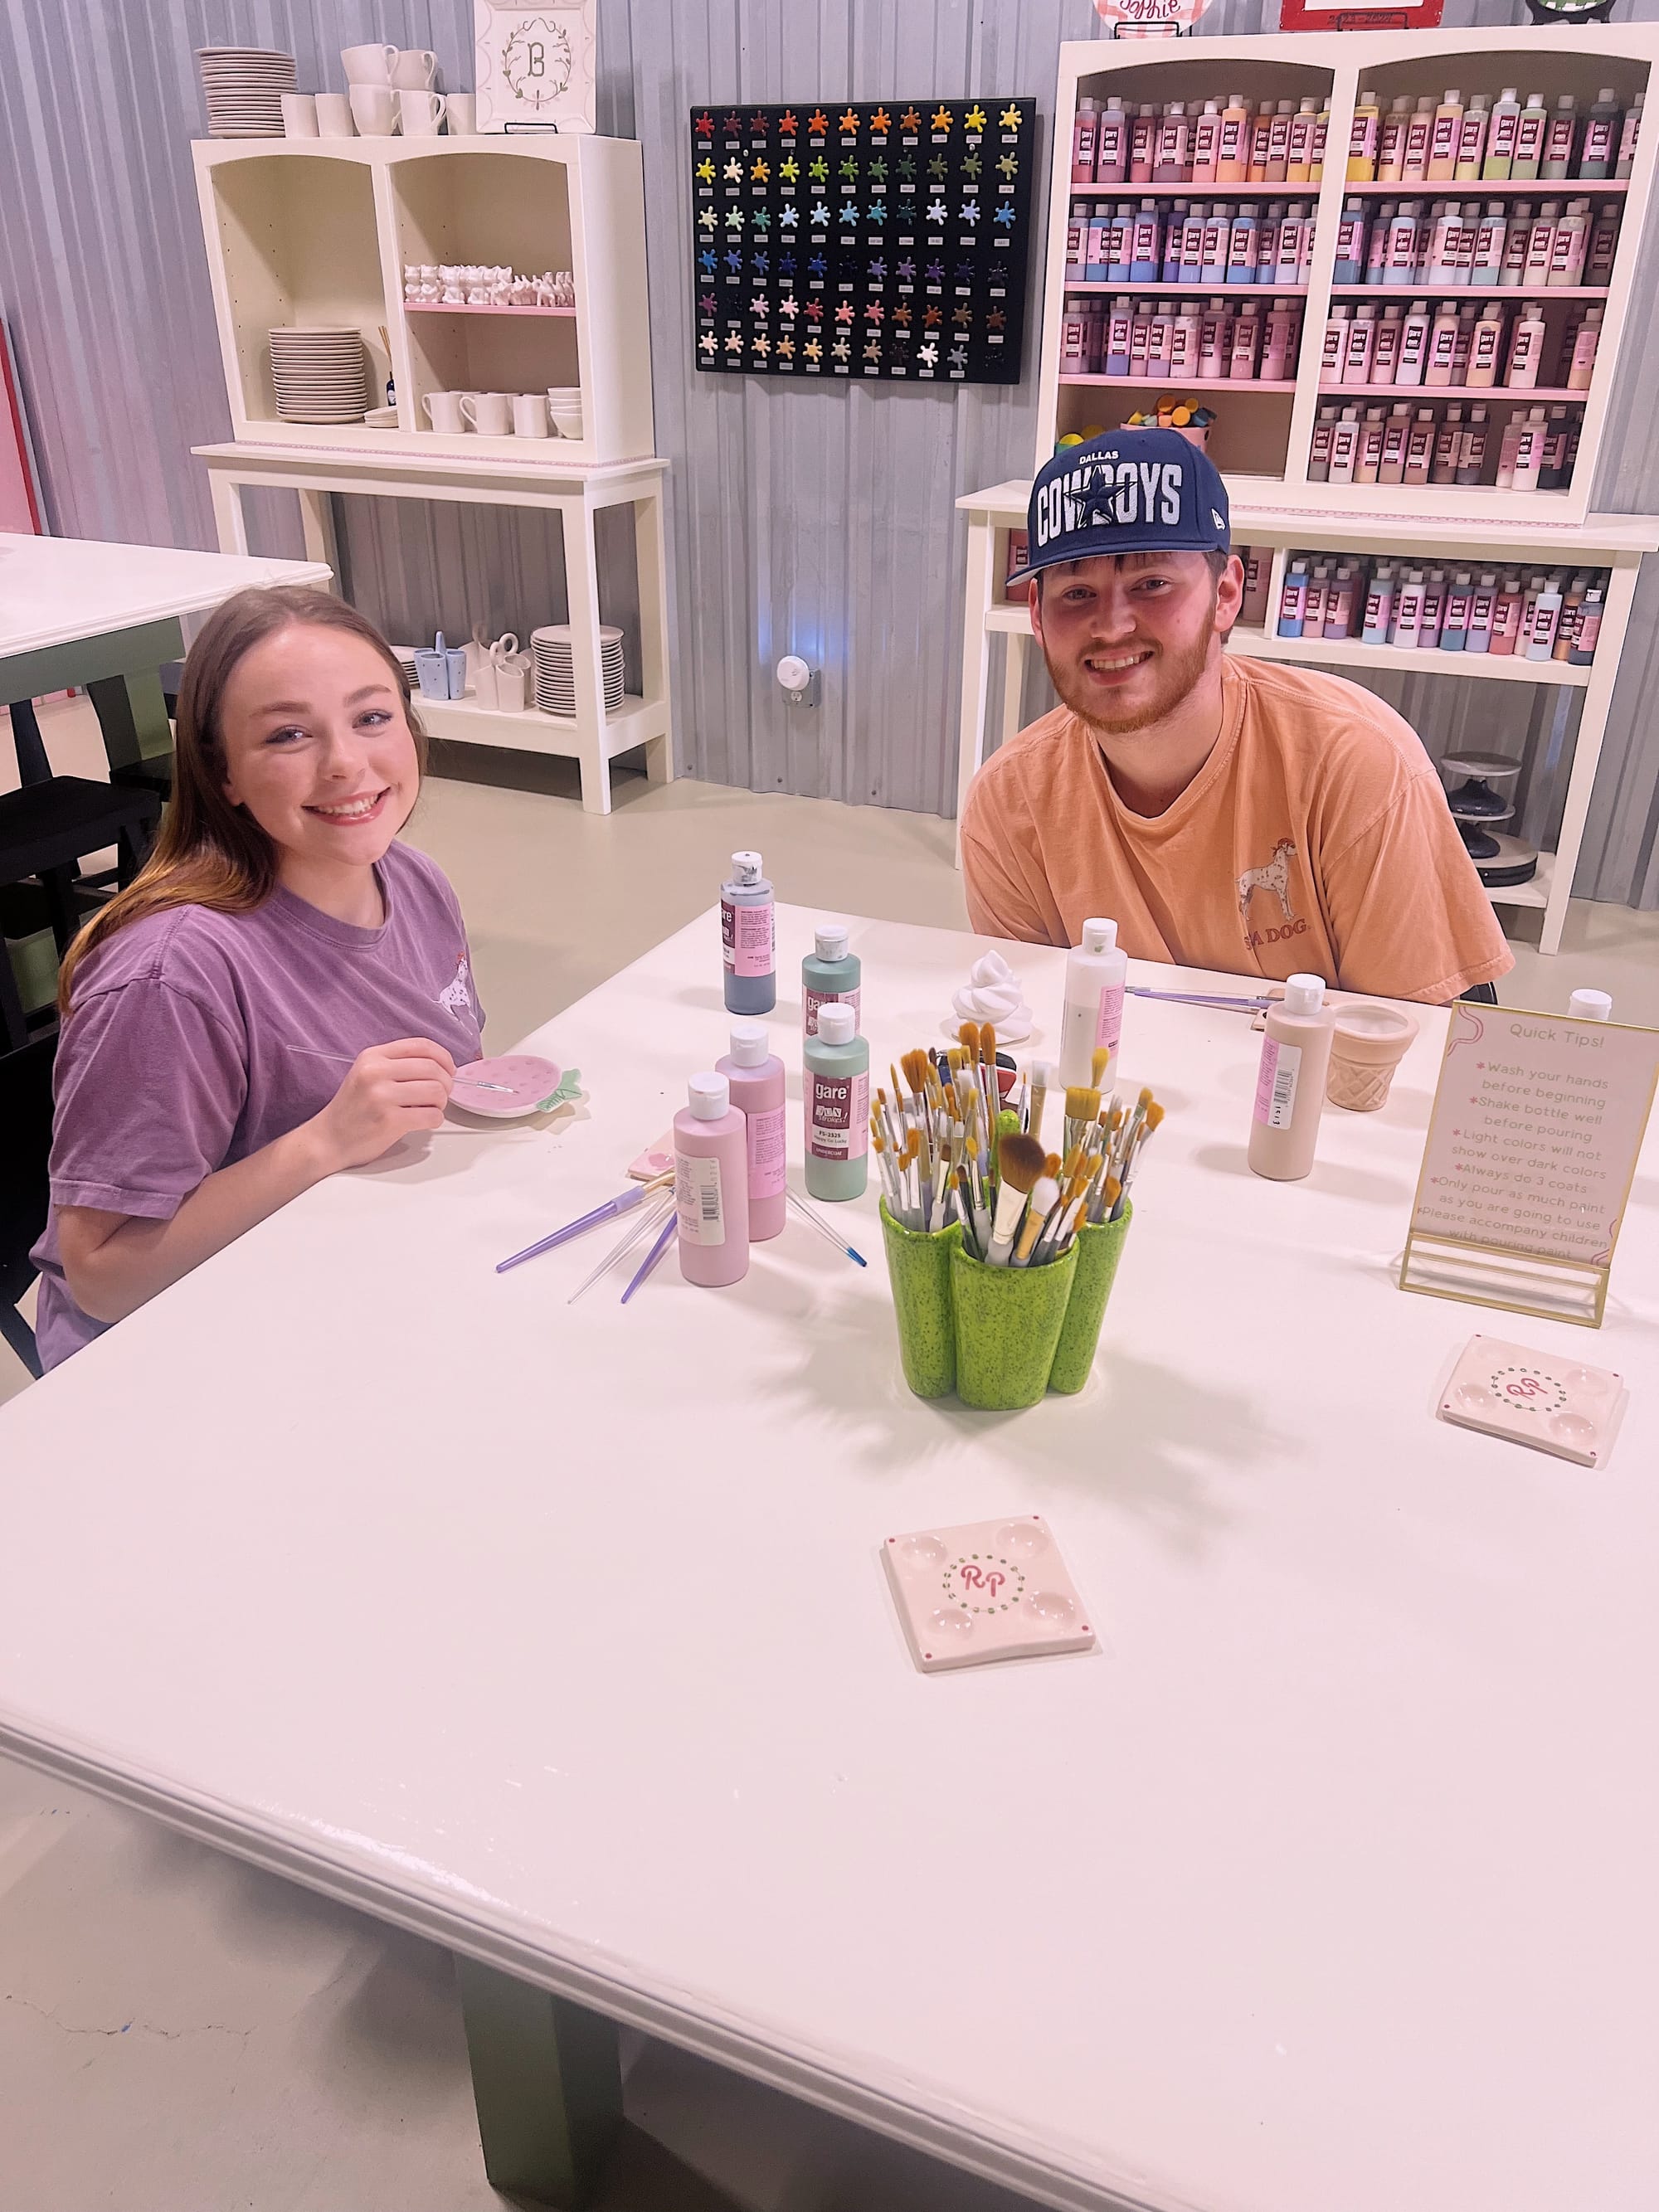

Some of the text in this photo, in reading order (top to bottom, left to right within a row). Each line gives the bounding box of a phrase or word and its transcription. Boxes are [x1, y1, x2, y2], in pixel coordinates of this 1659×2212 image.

[527, 42, 545, 77] B
[1080, 451, 1119, 464] DALLAS
[1510, 1023, 1604, 1048] Quick Tips!
[1488, 1062, 1609, 1089] Wash your hands
[815, 1083, 848, 1100] gare
[1481, 1080, 1607, 1110] before beginning
[1478, 1096, 1603, 1125] Shake bottle well
[1463, 1129, 1603, 1161] Light colors will not
[1484, 1116, 1592, 1144] before pouring
[1452, 1145, 1607, 1179] show over dark colors
[1462, 1164, 1587, 1194] Always do 3 coats
[1438, 1176, 1606, 1214] Only pour as much paint
[1439, 1194, 1600, 1230] as you are going to use
[1422, 1206, 1608, 1249] Please accompany children
[1449, 1228, 1573, 1259] with pouring paint
